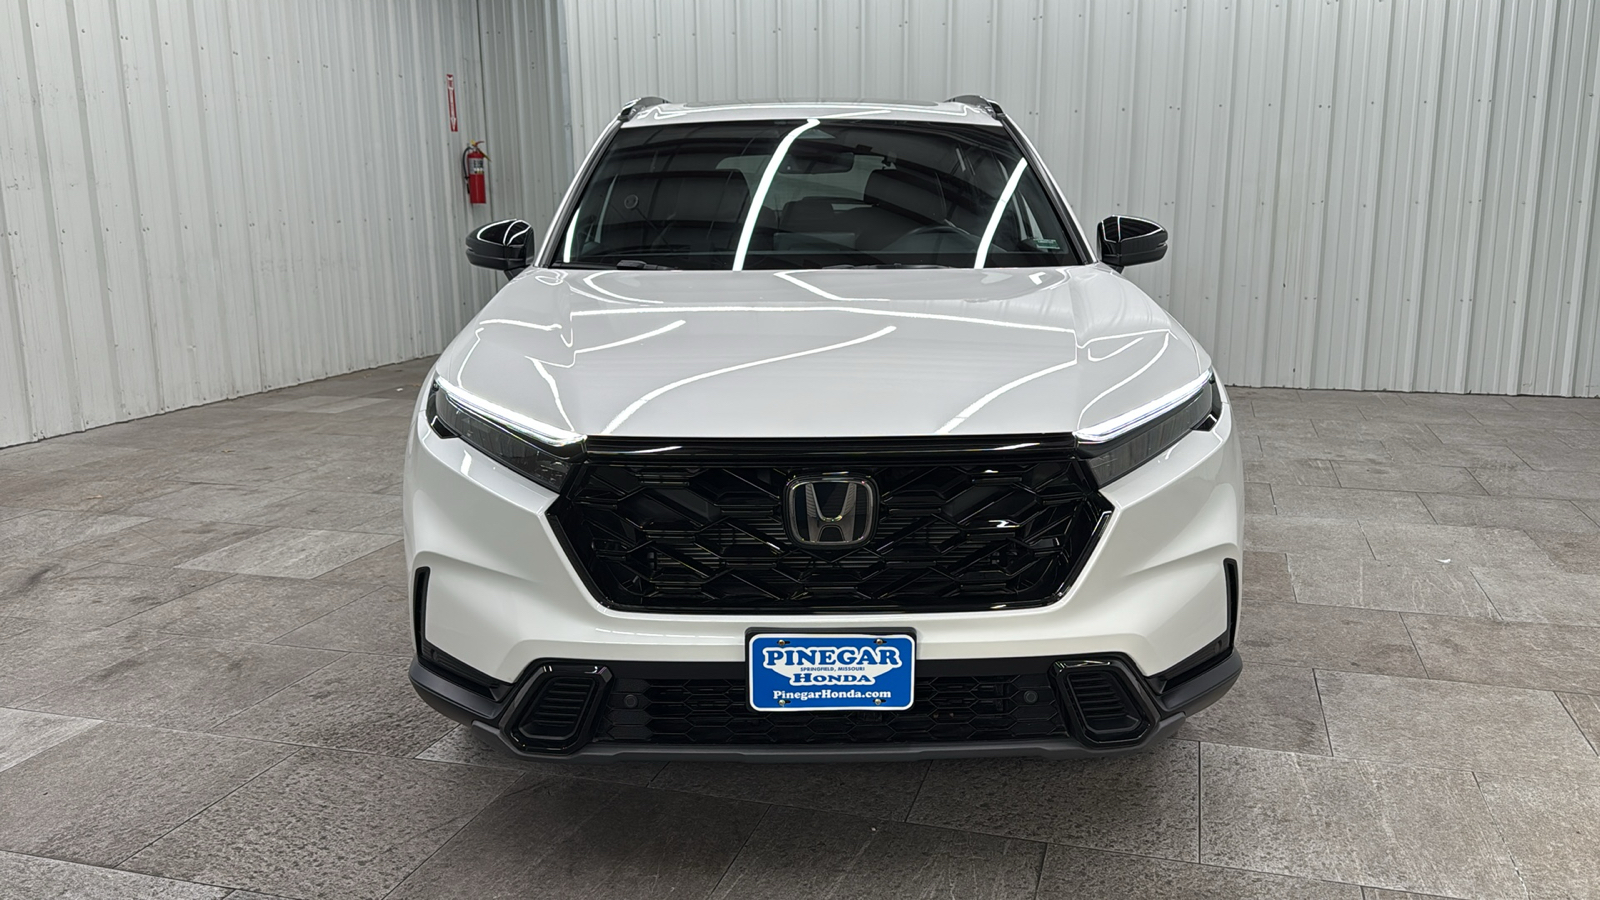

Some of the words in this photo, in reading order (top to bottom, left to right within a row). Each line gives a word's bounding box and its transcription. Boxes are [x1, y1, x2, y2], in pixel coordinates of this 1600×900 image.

[765, 649, 900, 666] PINEGAR
[792, 673, 872, 683] HONDA
[773, 689, 892, 701] PinegarHonda.com
